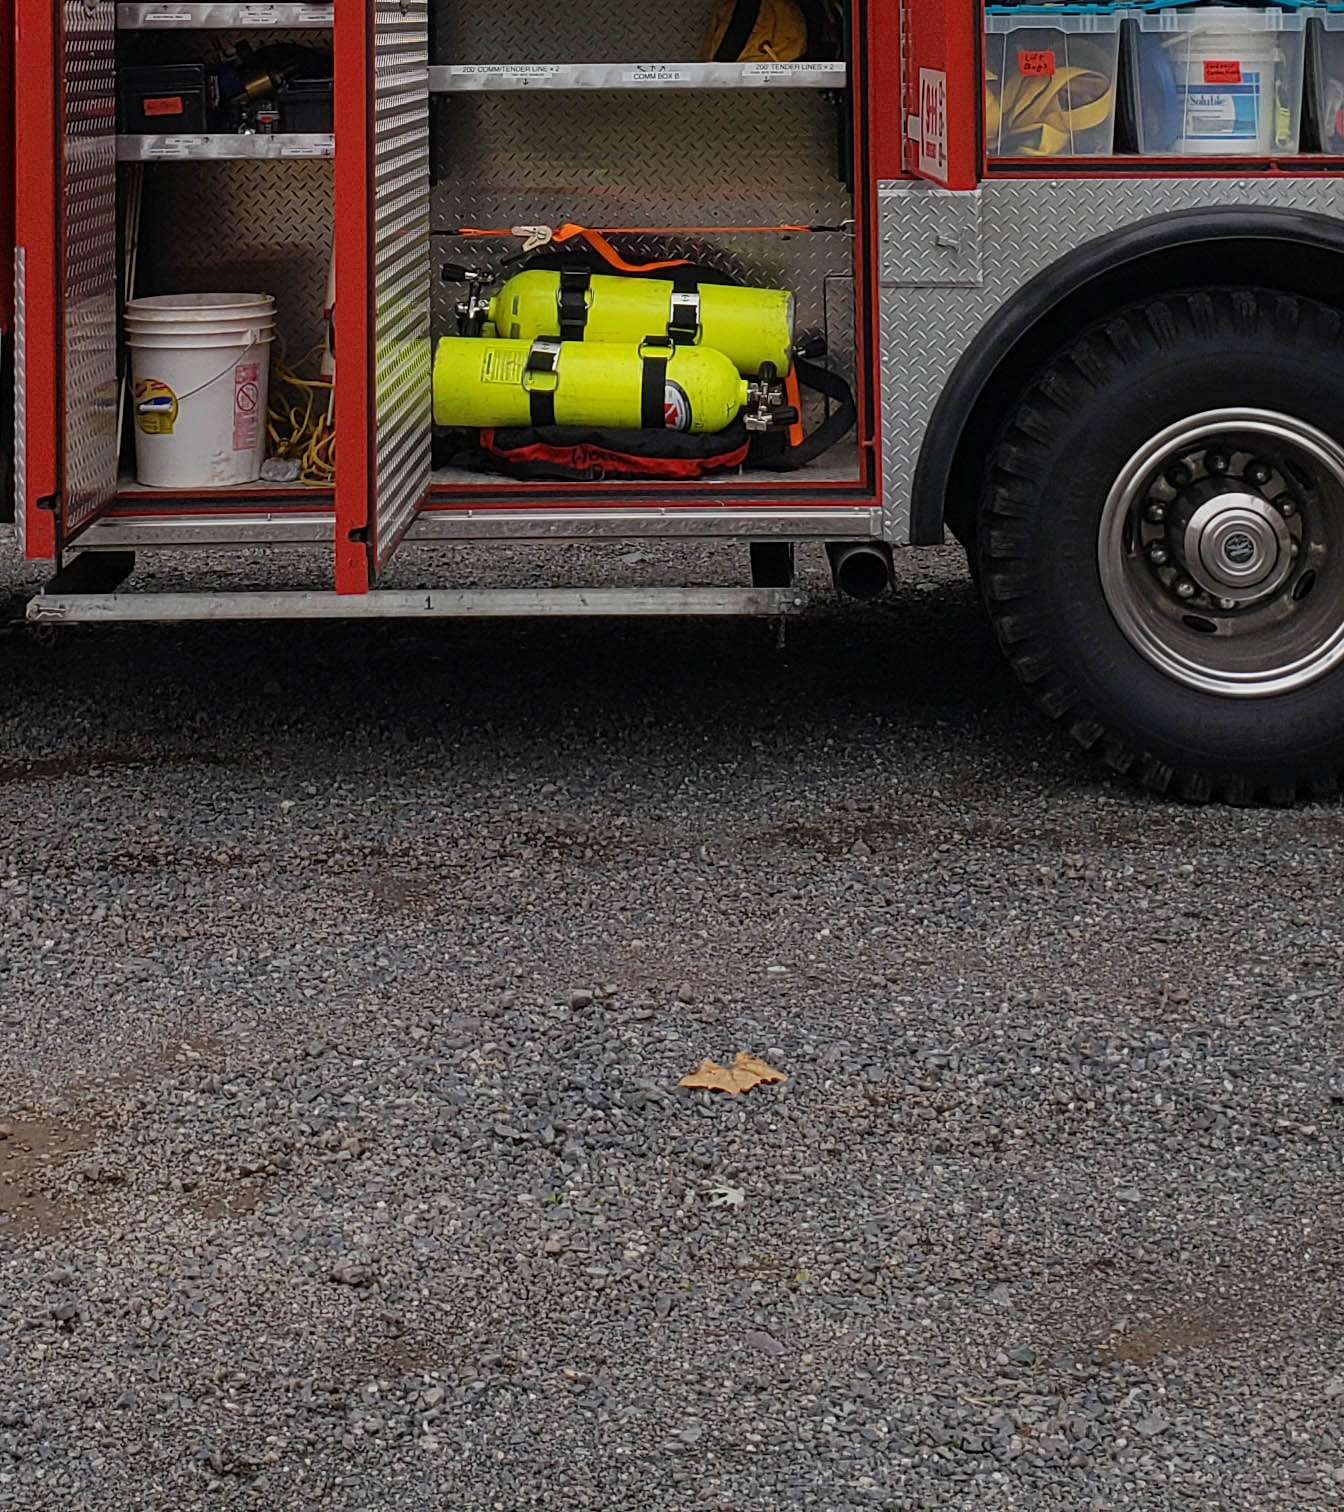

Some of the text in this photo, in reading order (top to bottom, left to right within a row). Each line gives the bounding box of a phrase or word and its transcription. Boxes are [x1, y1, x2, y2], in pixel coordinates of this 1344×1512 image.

[771, 63, 799, 71] TENDER
[633, 72, 656, 80] COMM
[657, 72, 673, 80] BOX
